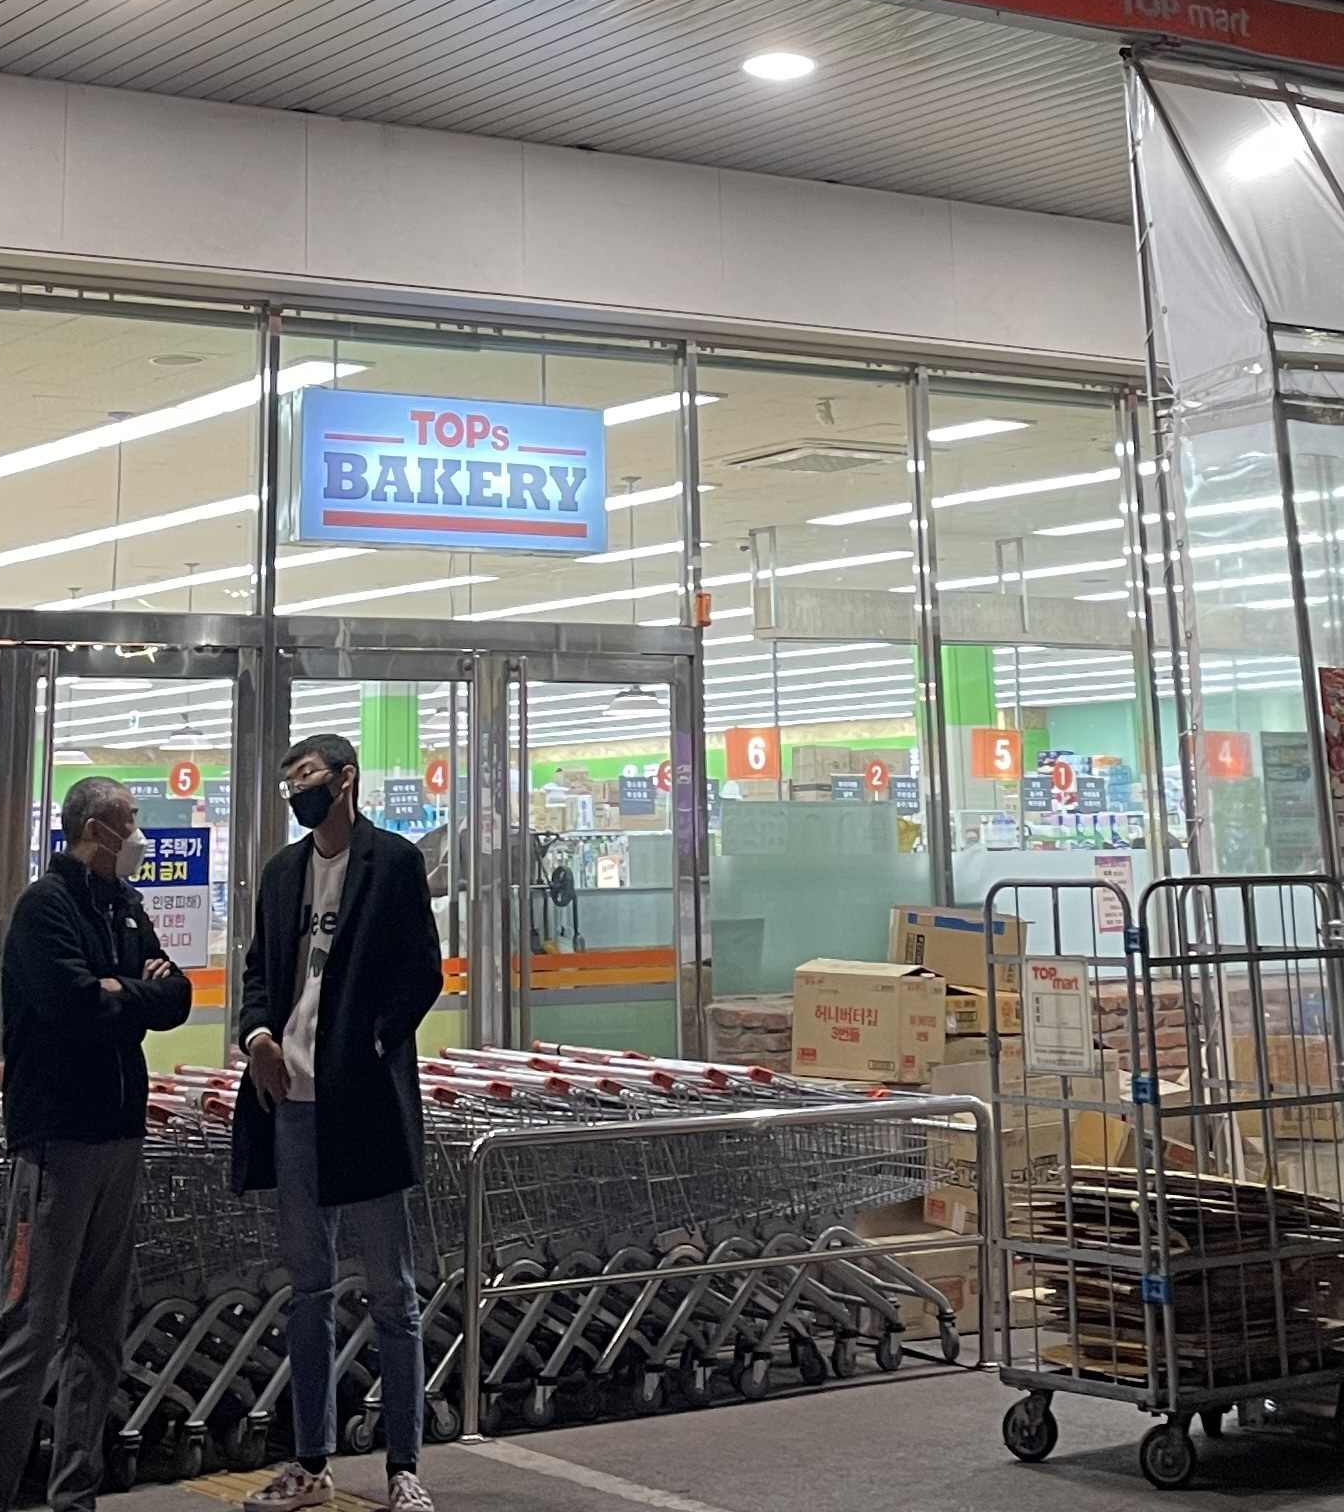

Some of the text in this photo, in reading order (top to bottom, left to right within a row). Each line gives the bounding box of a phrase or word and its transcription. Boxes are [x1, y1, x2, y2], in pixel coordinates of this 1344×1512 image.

[1188, 3, 1250, 36] mart
[323, 451, 587, 512] BAKERY
[747, 735, 766, 771] 6
[994, 740, 1012, 770] 5
[1218, 739, 1233, 767] 4
[177, 768, 192, 791] 5
[431, 768, 444, 785] 4
[871, 766, 882, 786] 2
[1058, 767, 1066, 785] 1
[159, 838, 203, 858] 주택가
[160, 861, 188, 881] 금지
[298, 903, 337, 937] Jee
[1031, 966, 1057, 982] TOP
[1052, 975, 1079, 990] mart
[815, 1004, 878, 1027] 허니버터칩
